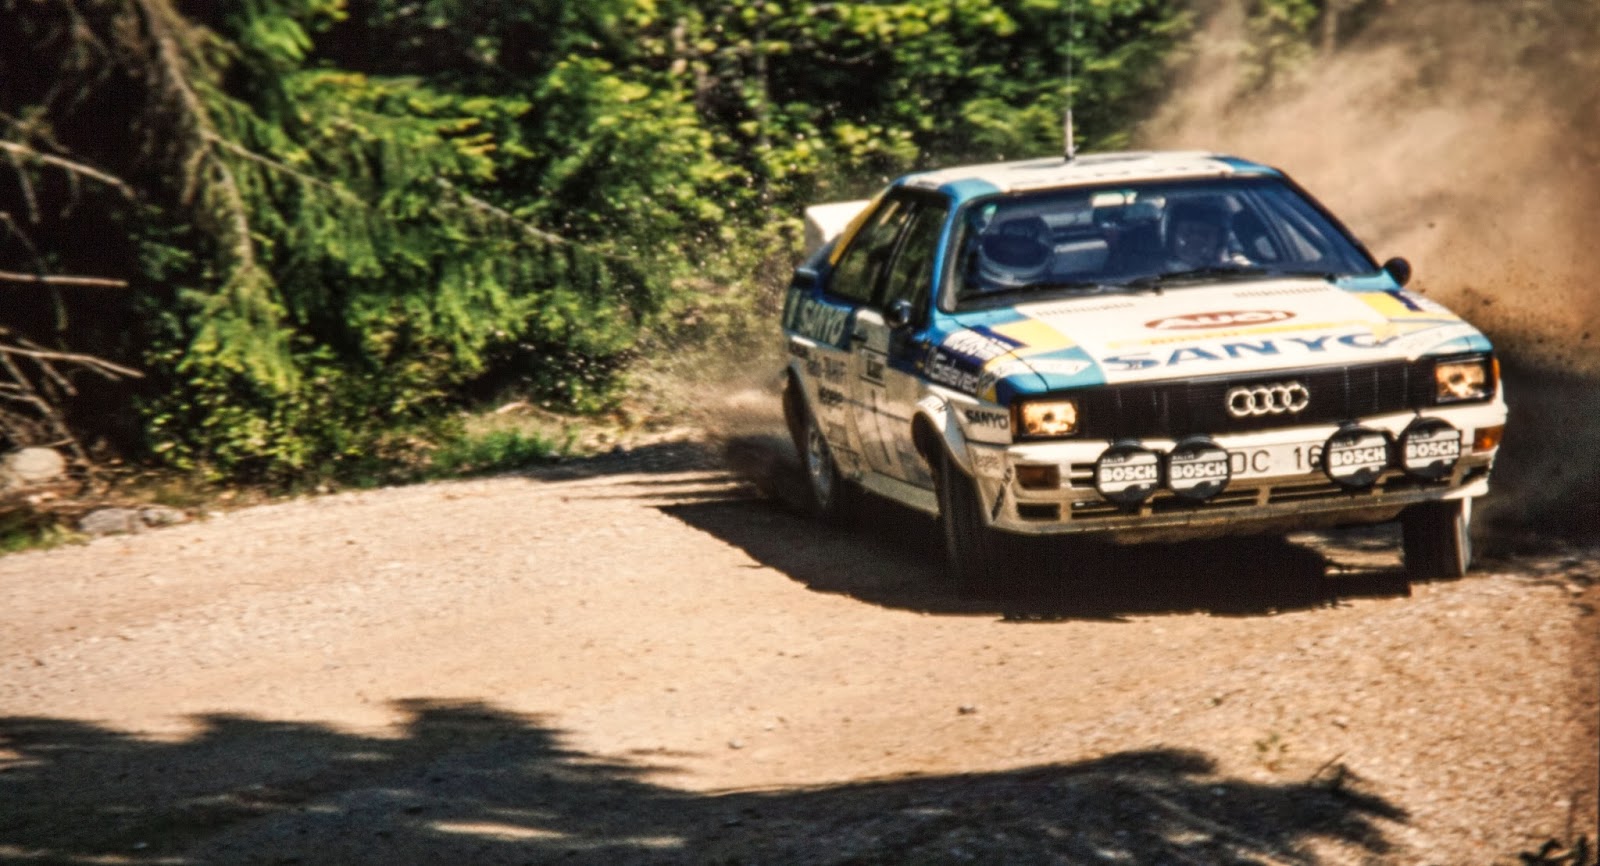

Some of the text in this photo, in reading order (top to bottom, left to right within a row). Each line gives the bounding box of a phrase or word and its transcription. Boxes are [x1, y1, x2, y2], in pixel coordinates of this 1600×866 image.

[1102, 333, 1399, 371] SANYO
[965, 409, 1009, 430] SANYO
[1330, 446, 1387, 467] BOSCH
[1406, 440, 1460, 459] BOSCH
[1100, 464, 1158, 482] BOSCH
[1170, 461, 1228, 480] BOSCH
